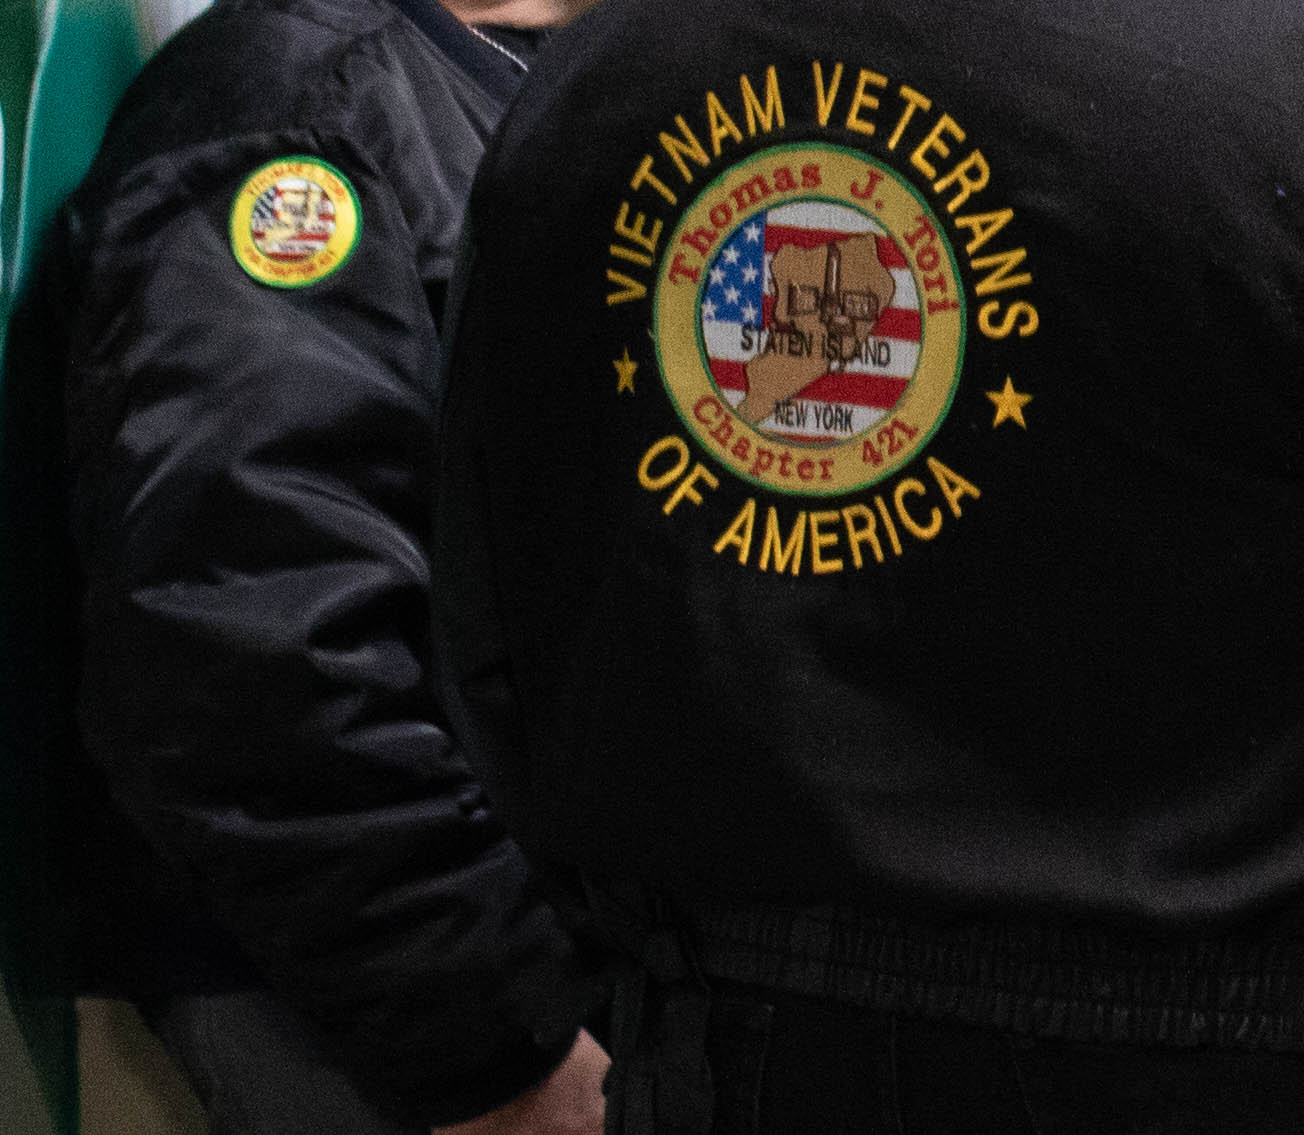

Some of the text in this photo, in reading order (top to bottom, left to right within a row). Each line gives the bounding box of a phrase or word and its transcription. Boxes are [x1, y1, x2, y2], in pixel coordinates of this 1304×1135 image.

[607, 60, 1039, 339] VIETNAM VETERANS
[669, 164, 960, 314] Thomas J. Tori
[741, 325, 891, 368] STATEN ISLAND
[693, 395, 919, 482] Chapter 421
[775, 399, 854, 433] NEW YORK
[637, 435, 982, 576] OF AMERICA
